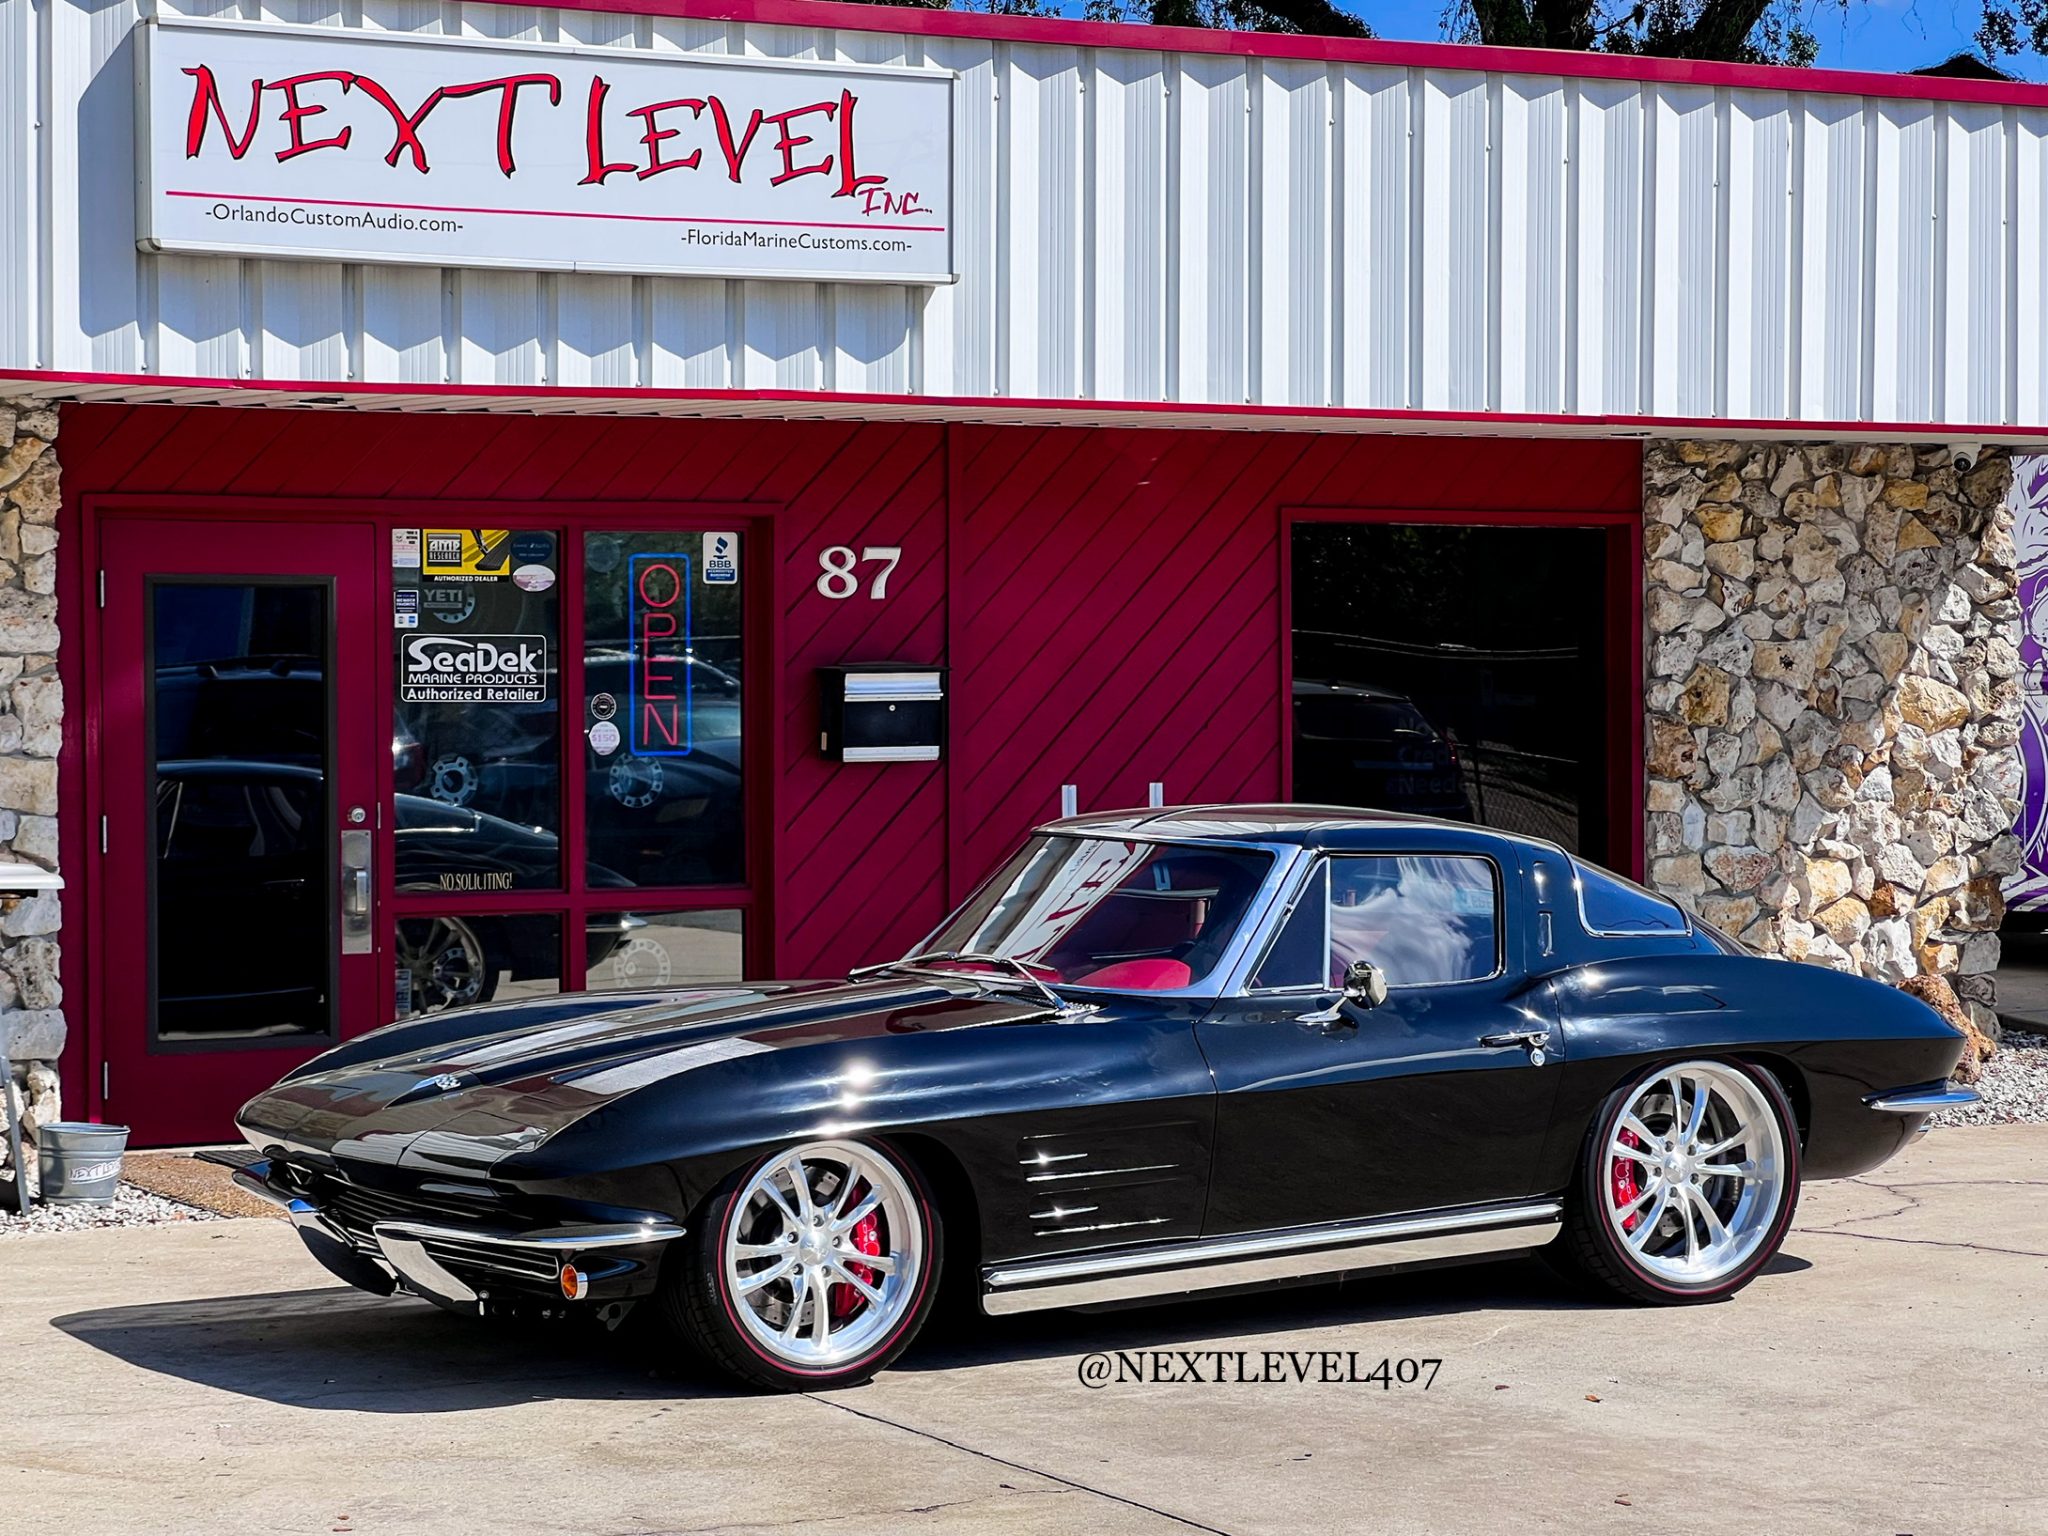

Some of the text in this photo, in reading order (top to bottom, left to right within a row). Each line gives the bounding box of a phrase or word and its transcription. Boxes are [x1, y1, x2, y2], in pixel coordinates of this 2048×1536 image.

[181, 64, 888, 198] NEXT LEVEL
[205, 203, 464, 233] -OrlandoCustomAudio.com-
[680, 228, 913, 254] -FloridaMarineCustoms.com-
[709, 560, 732, 568] BBB
[816, 545, 902, 600] 87
[423, 589, 463, 602] YETI
[408, 637, 538, 672] SeaDek
[639, 563, 681, 746] OPEN
[408, 673, 538, 684] MARINE PRODUCTS
[407, 688, 540, 700] Authorized Retailer
[440, 872, 513, 891] NO SOLICITING!
